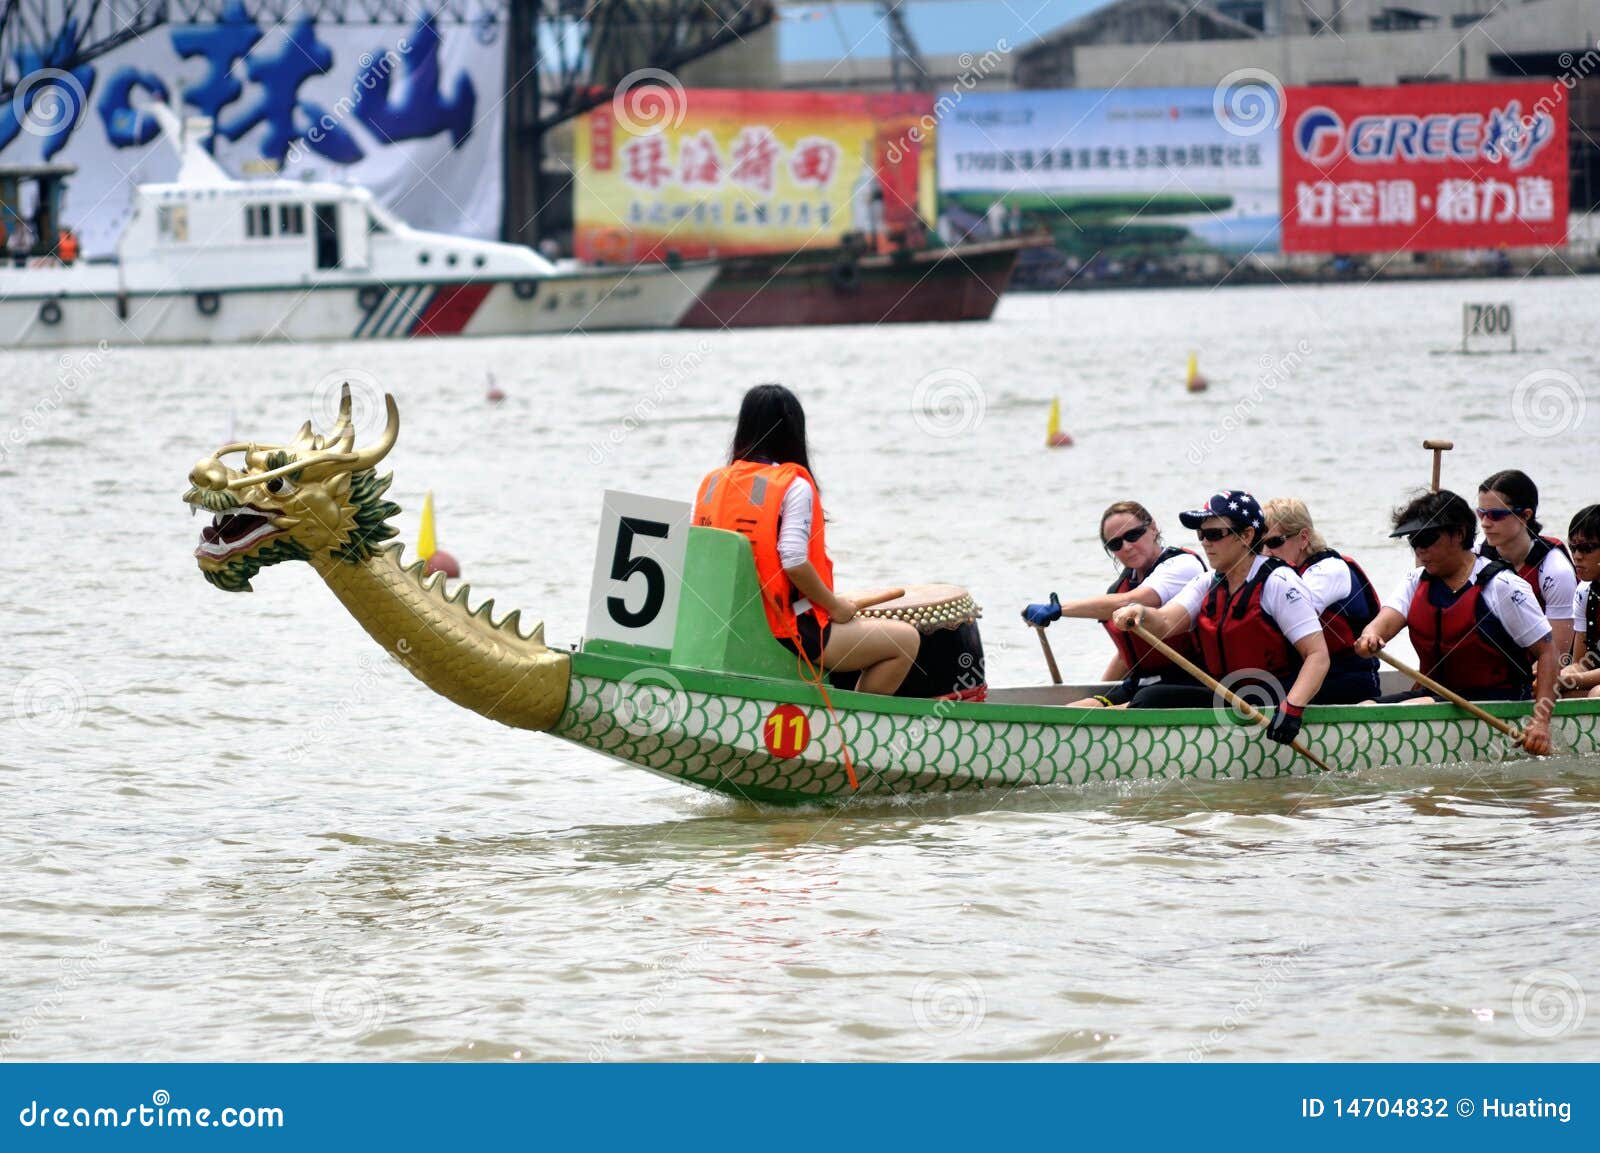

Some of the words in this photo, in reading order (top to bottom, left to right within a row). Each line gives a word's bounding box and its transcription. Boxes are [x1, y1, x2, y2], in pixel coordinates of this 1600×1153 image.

[1348, 113, 1483, 162] GREE
[1469, 304, 1511, 335] 700
[606, 516, 670, 628] 5
[767, 714, 805, 750] 11
